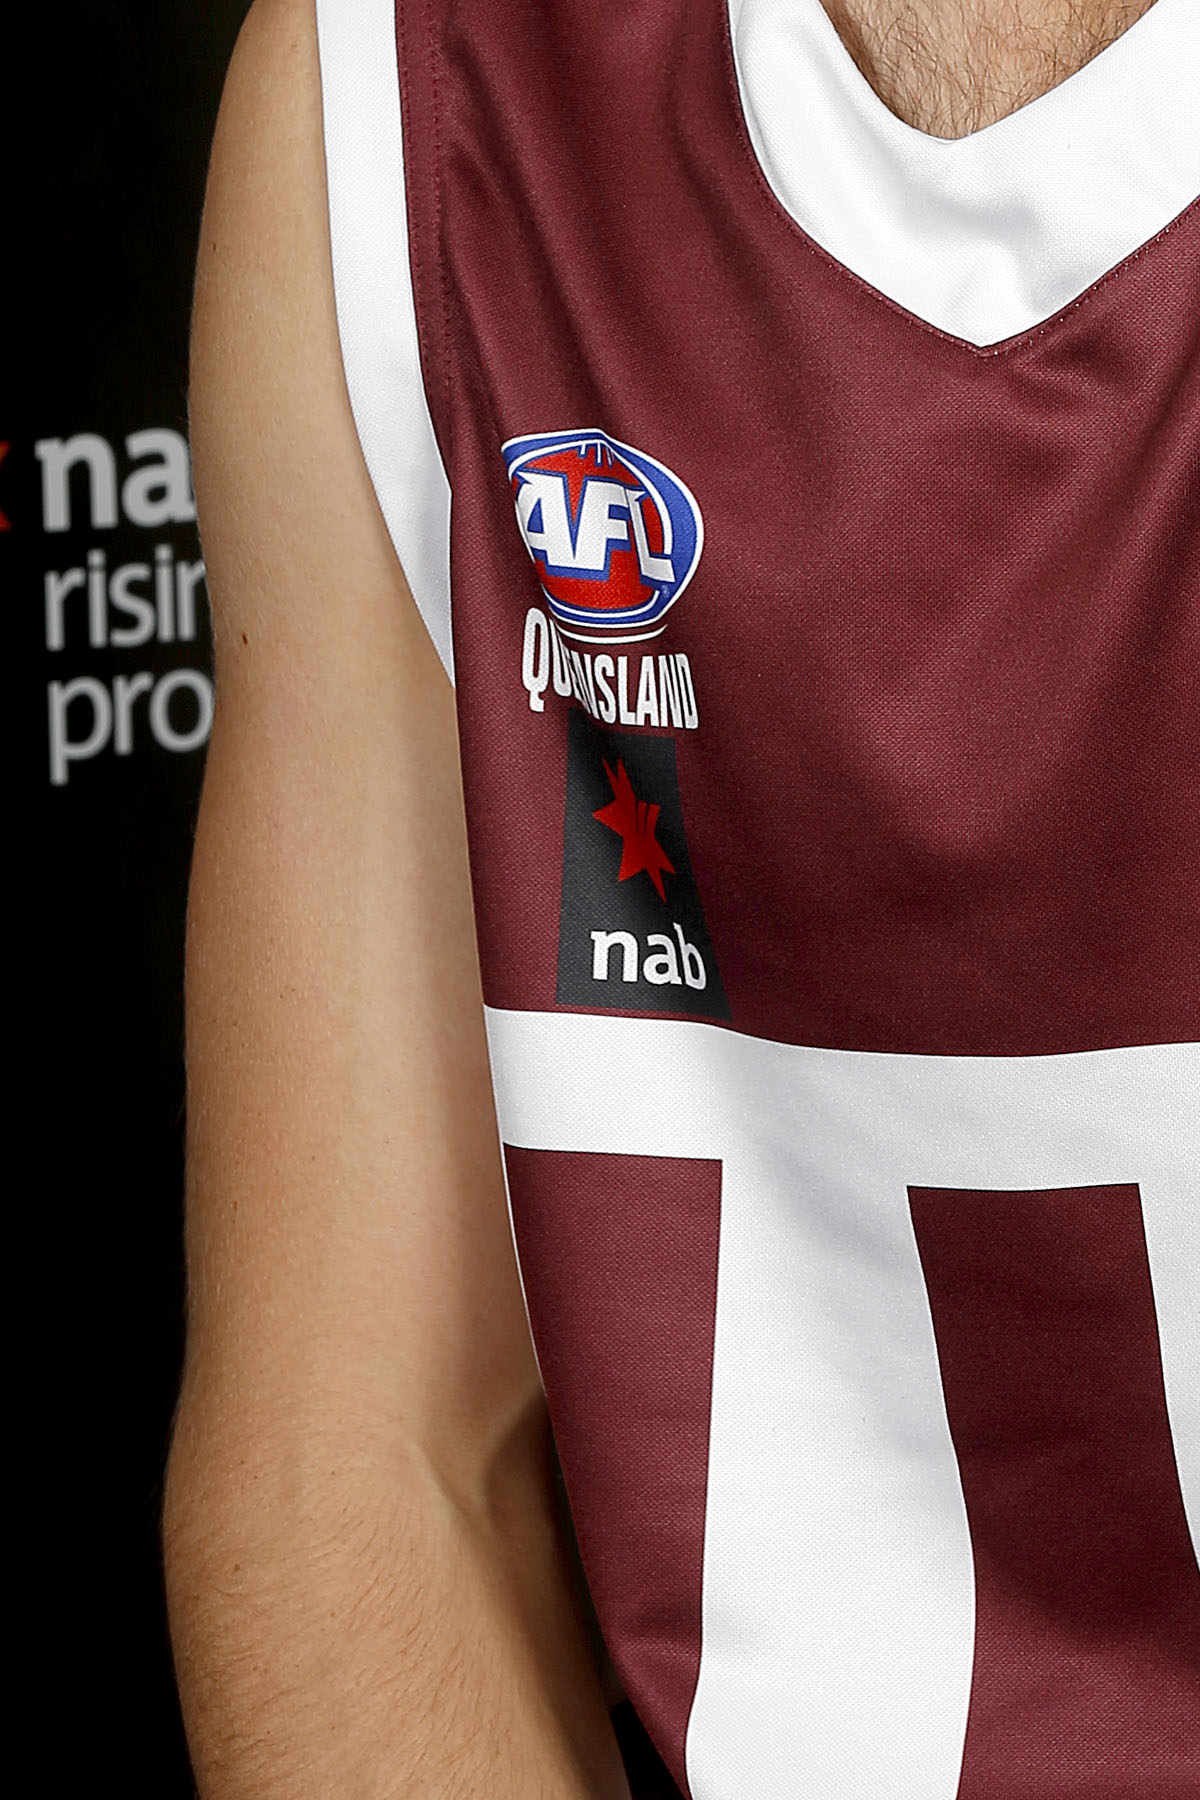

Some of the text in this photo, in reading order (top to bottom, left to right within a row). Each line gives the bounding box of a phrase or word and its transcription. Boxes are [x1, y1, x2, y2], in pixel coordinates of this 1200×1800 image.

[517, 470, 676, 585] AFL
[521, 607, 699, 730] QUNSLAND
[590, 923, 708, 992] nab
